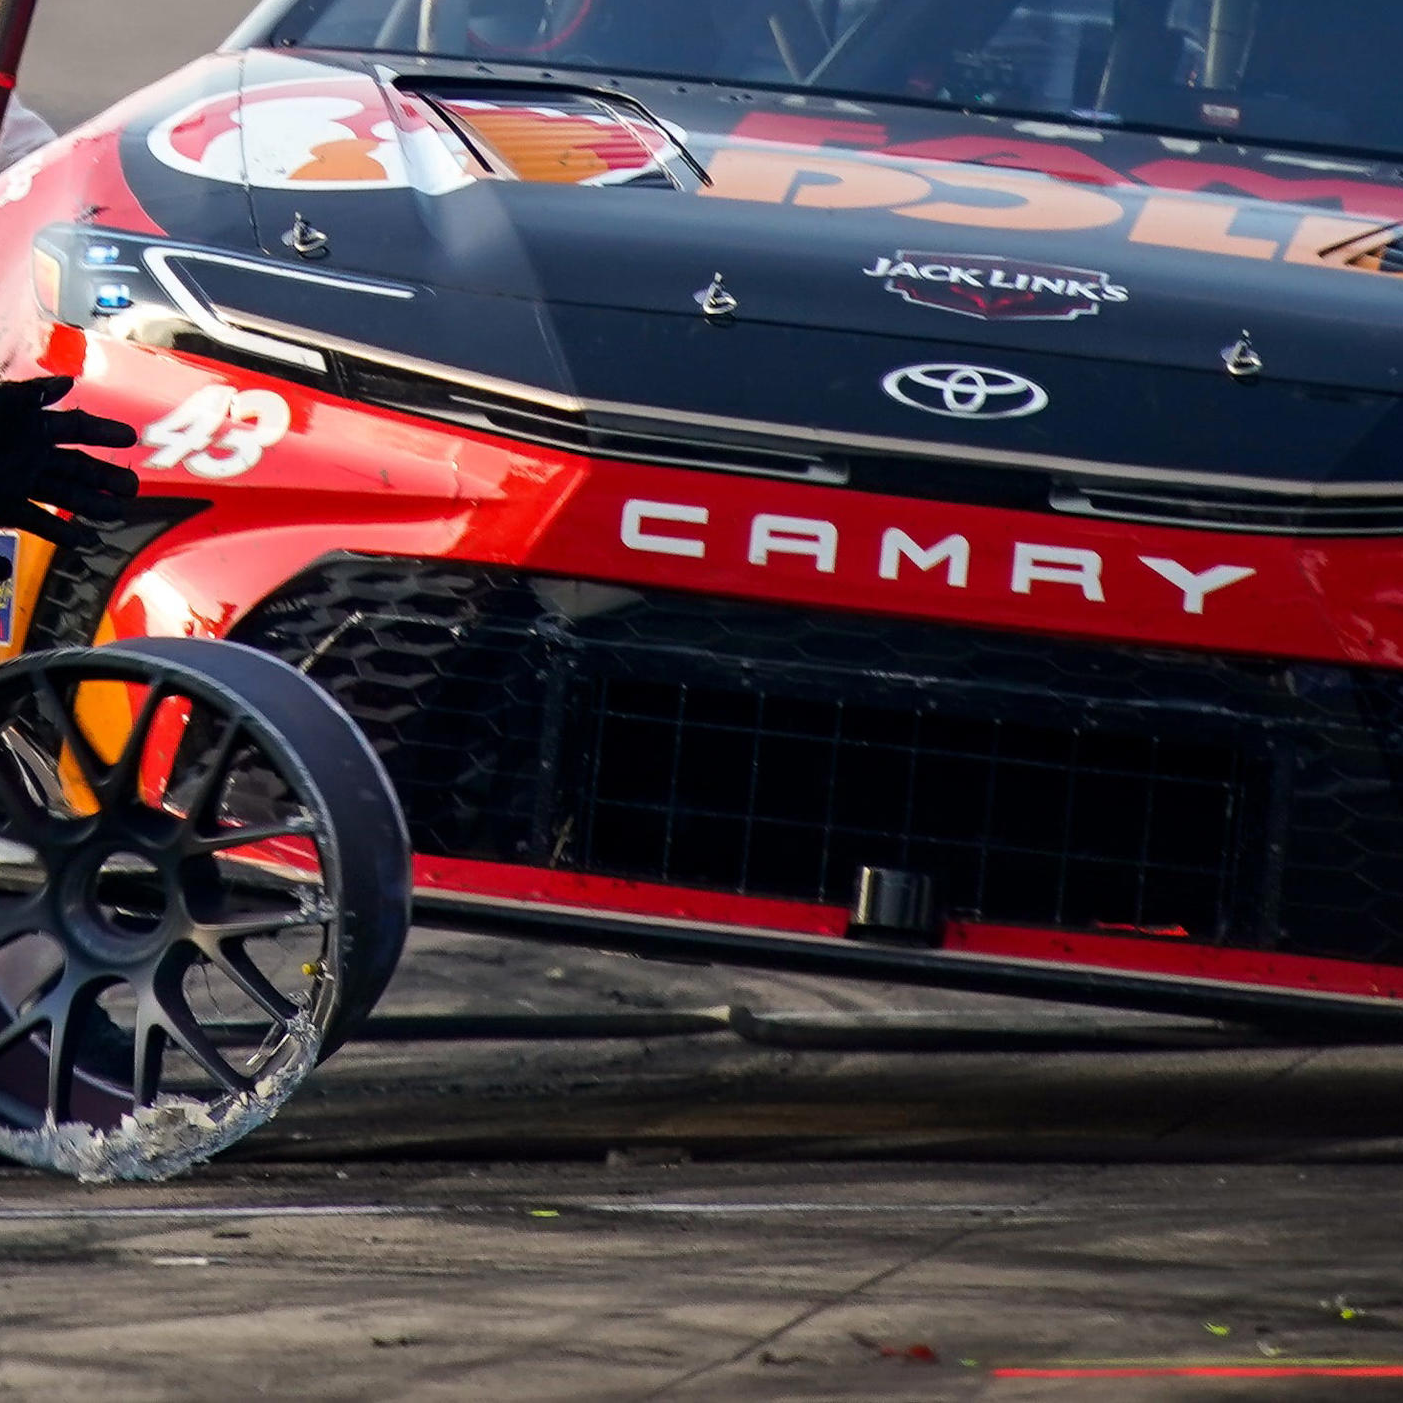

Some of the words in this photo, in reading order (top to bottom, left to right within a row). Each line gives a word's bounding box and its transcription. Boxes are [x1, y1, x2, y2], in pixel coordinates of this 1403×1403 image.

[862, 256, 985, 289] JACK
[139, 383, 291, 479] 43
[620, 498, 1258, 615] CAMRY
